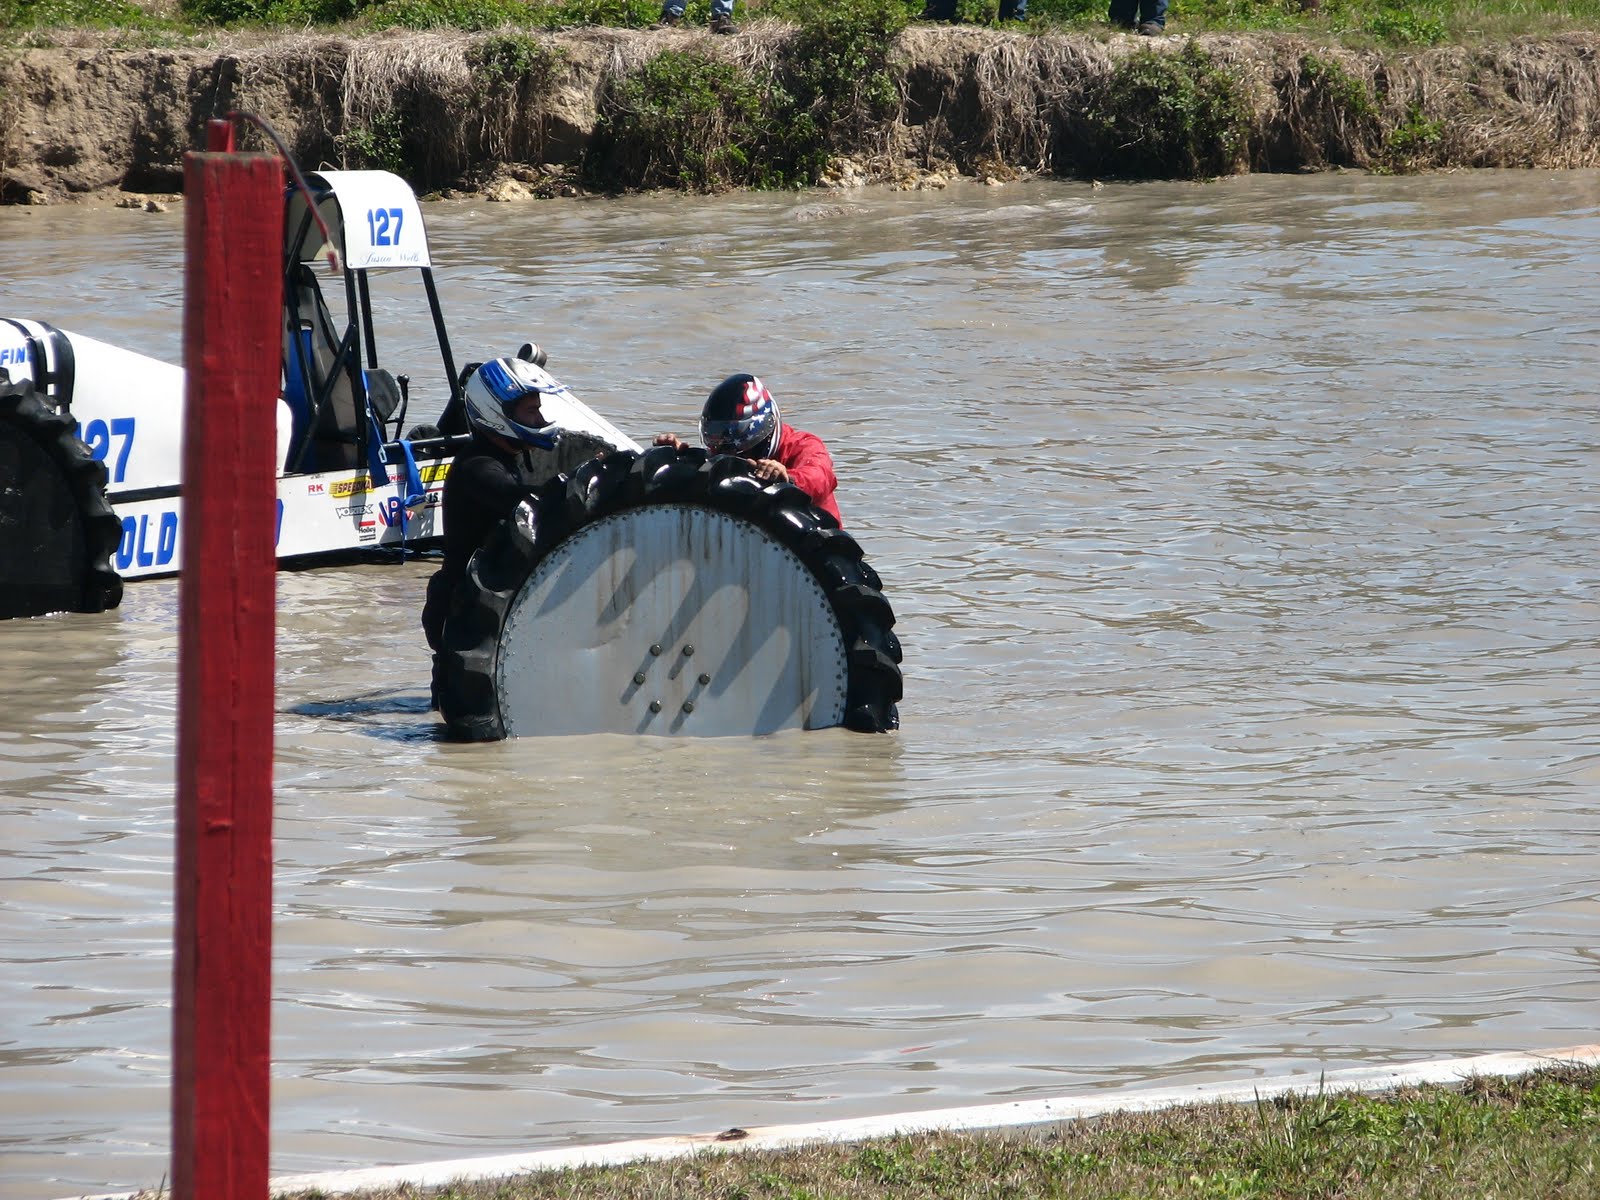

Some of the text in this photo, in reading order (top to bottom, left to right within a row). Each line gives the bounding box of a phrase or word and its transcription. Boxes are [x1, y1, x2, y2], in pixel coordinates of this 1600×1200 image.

[367, 208, 403, 246] 127
[0, 346, 33, 366] FIN
[73, 417, 135, 483] 27
[308, 484, 324, 493] RK
